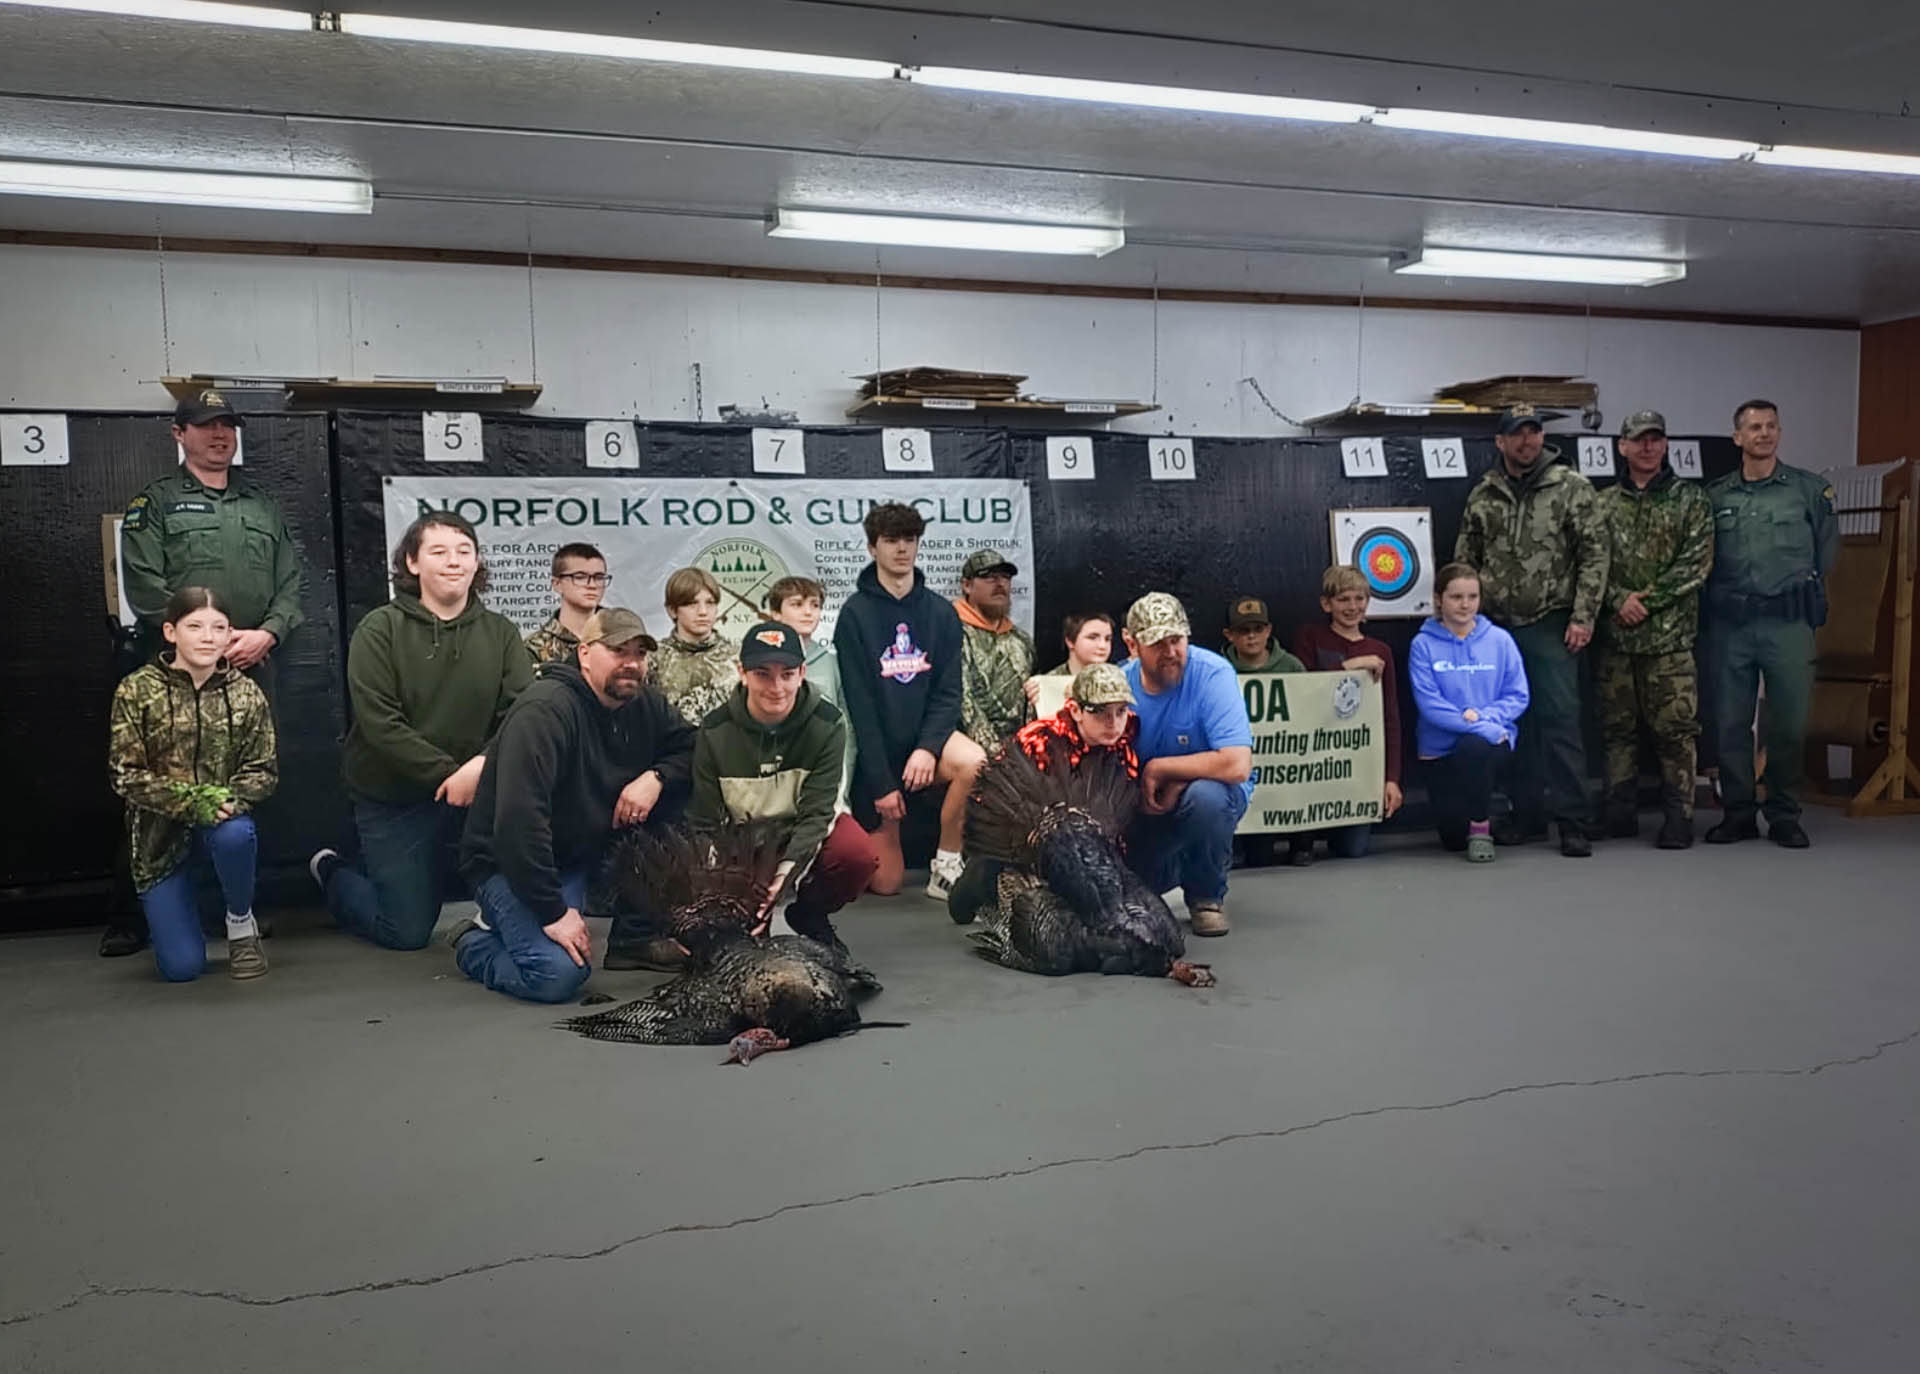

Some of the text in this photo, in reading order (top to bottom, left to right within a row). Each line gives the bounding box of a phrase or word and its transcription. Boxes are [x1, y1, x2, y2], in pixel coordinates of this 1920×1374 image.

[24, 426, 45, 453] 3
[444, 423, 462, 450] 5
[604, 431, 622, 457] 6
[769, 438, 785, 463] 7
[899, 438, 915, 461] 8
[1062, 446, 1077, 469] 9
[1158, 447, 1186, 470] 10
[1350, 448, 1375, 468] 11
[1431, 447, 1458, 468] 12
[1586, 446, 1608, 468] 13
[1673, 448, 1696, 469] 14
[416, 496, 1013, 527] NORFOLK ROD & GU CLUB
[493, 543, 521, 554] FOR
[711, 544, 763, 557] NORFOLK
[815, 540, 851, 551] RIFLE
[920, 540, 952, 550] ADER
[955, 539, 964, 549] &
[515, 558, 551, 568] RANG
[815, 553, 866, 563] COVERED
[955, 553, 971, 562] RA
[816, 566, 841, 576] TWO
[525, 583, 553, 593] COU
[494, 595, 541, 606] TARGET
[500, 608, 537, 618] PRIZE
[1243, 678, 1290, 724] OA
[1250, 723, 1371, 756] unting through
[1252, 756, 1352, 785] onservation
[1263, 800, 1379, 827] www.NYCOA.org
